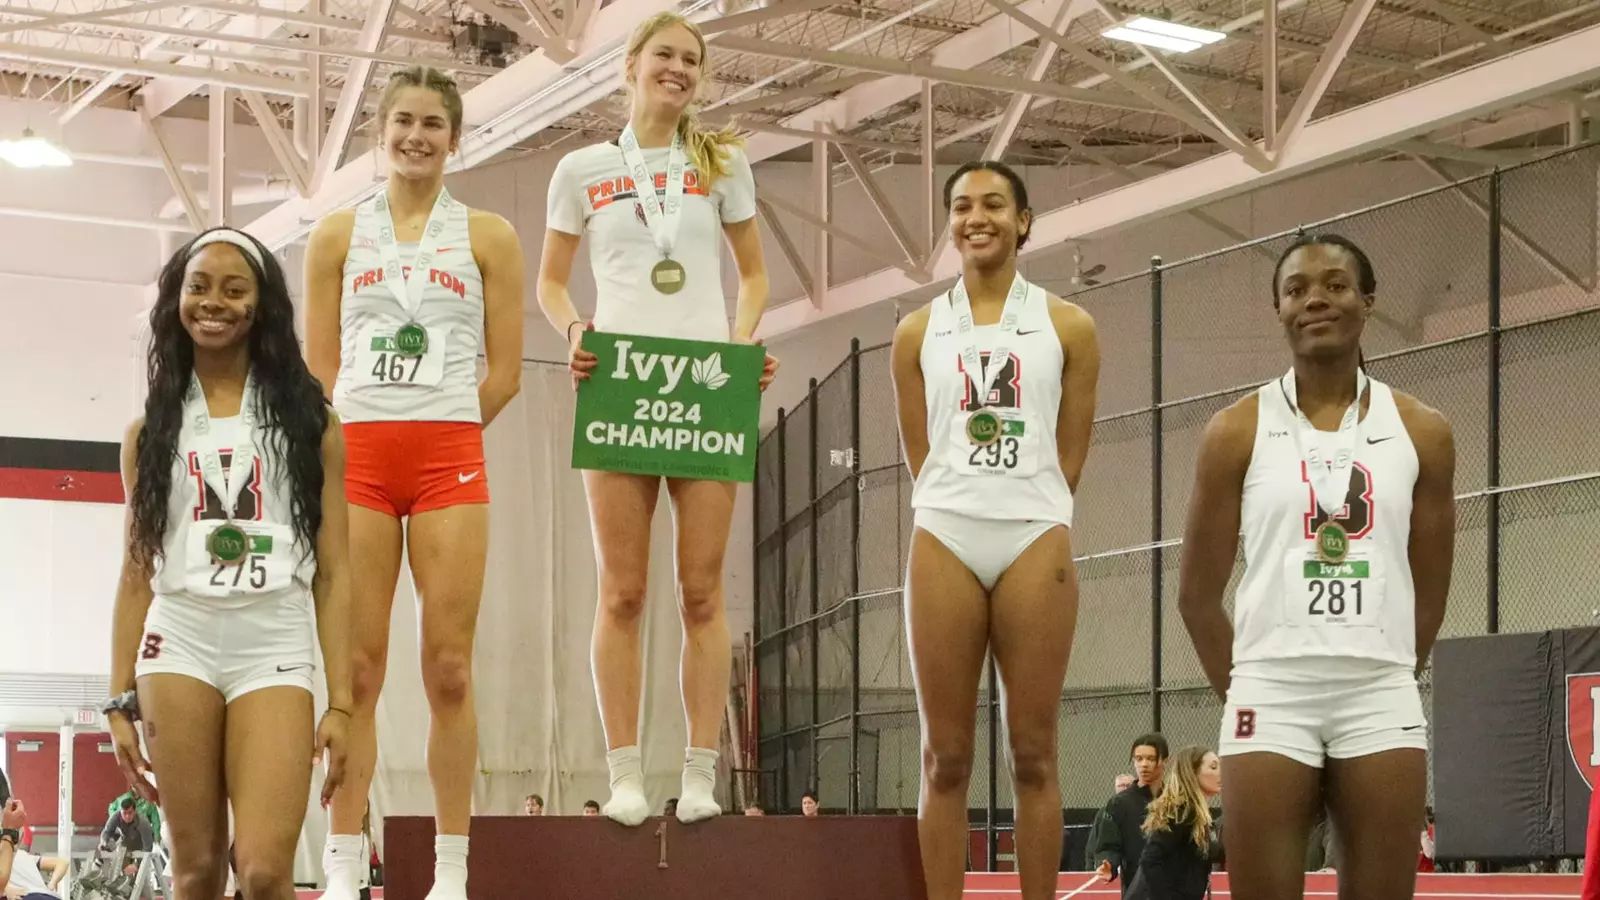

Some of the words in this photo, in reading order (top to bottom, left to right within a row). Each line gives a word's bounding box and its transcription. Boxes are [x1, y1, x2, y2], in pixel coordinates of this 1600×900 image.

[587, 170, 700, 204] PRINEO
[353, 266, 466, 299] PRICTON
[371, 352, 424, 383] 467
[611, 340, 689, 394] Ivy
[634, 399, 701, 424] 2024
[586, 422, 745, 456] CHAMPION
[968, 437, 1019, 469] 293
[1308, 579, 1363, 616] 281
[1234, 708, 1256, 739] B
[654, 821, 669, 868] 1
